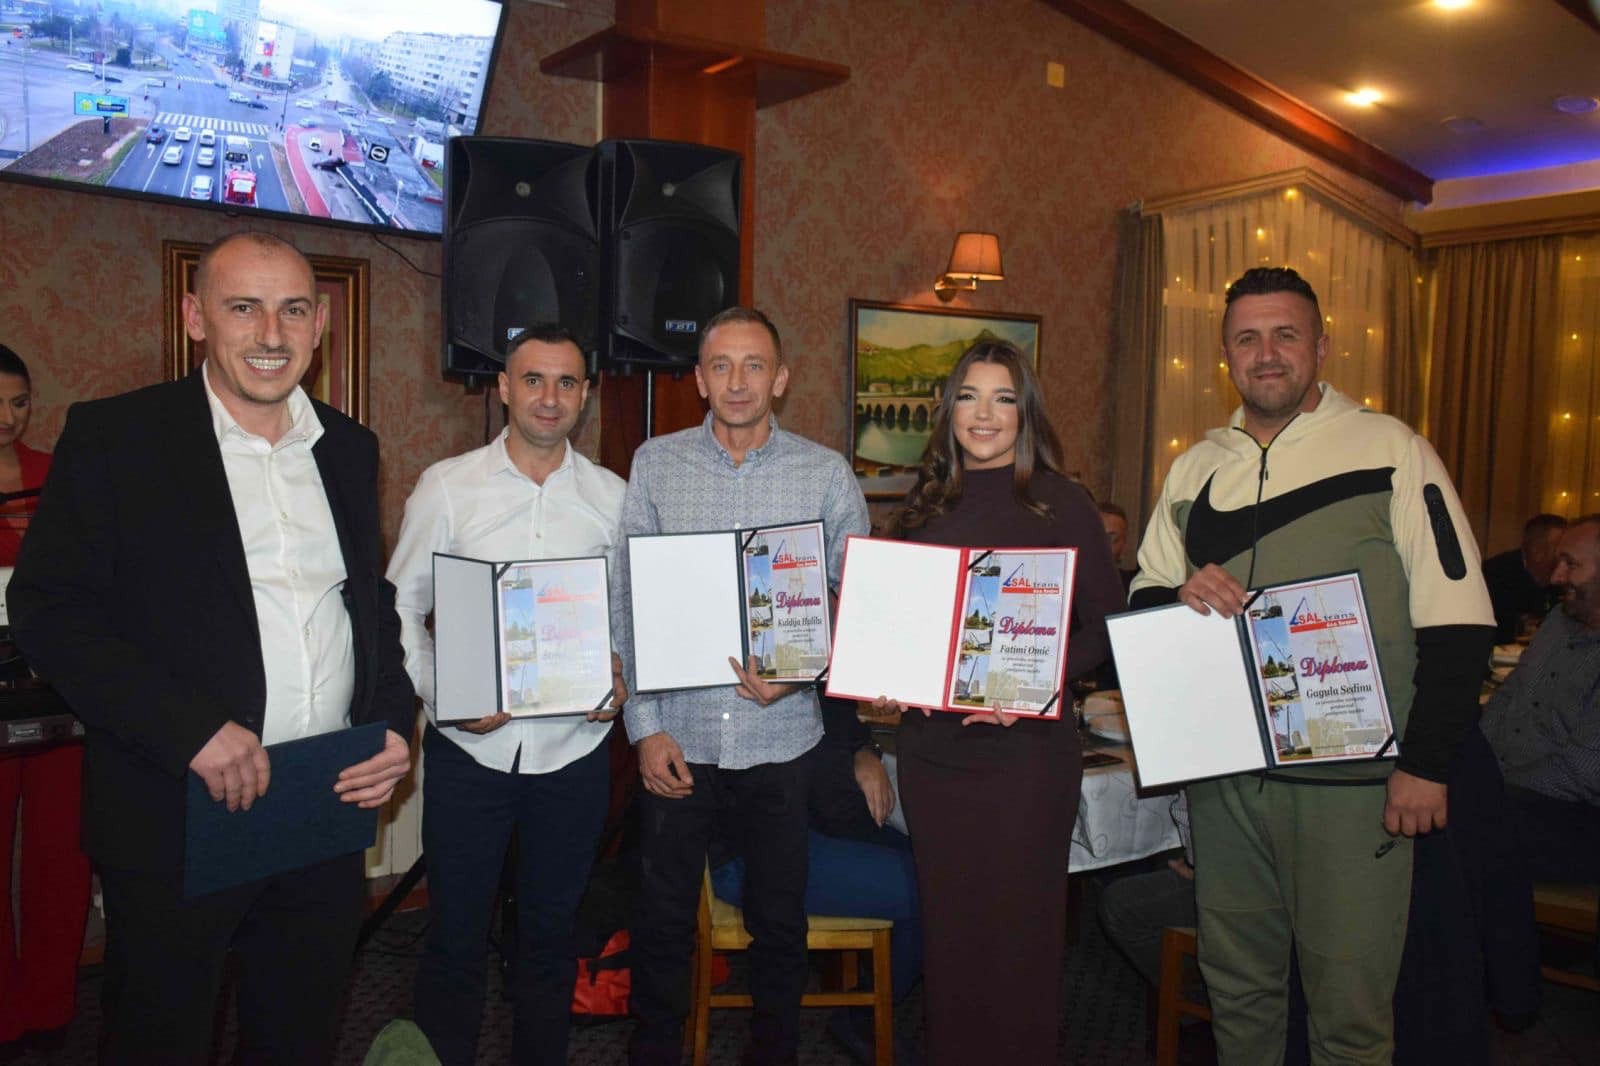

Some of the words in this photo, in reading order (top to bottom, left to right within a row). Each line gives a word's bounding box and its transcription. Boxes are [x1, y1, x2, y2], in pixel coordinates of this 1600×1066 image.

[778, 553, 794, 562] SAL
[1011, 577, 1031, 587] SAL
[1298, 612, 1322, 624] SAL
[1323, 612, 1355, 621] trans
[1000, 644, 1027, 655] Fatimi
[1306, 686, 1339, 699] Gagula
[1340, 683, 1372, 695] Sedinu
